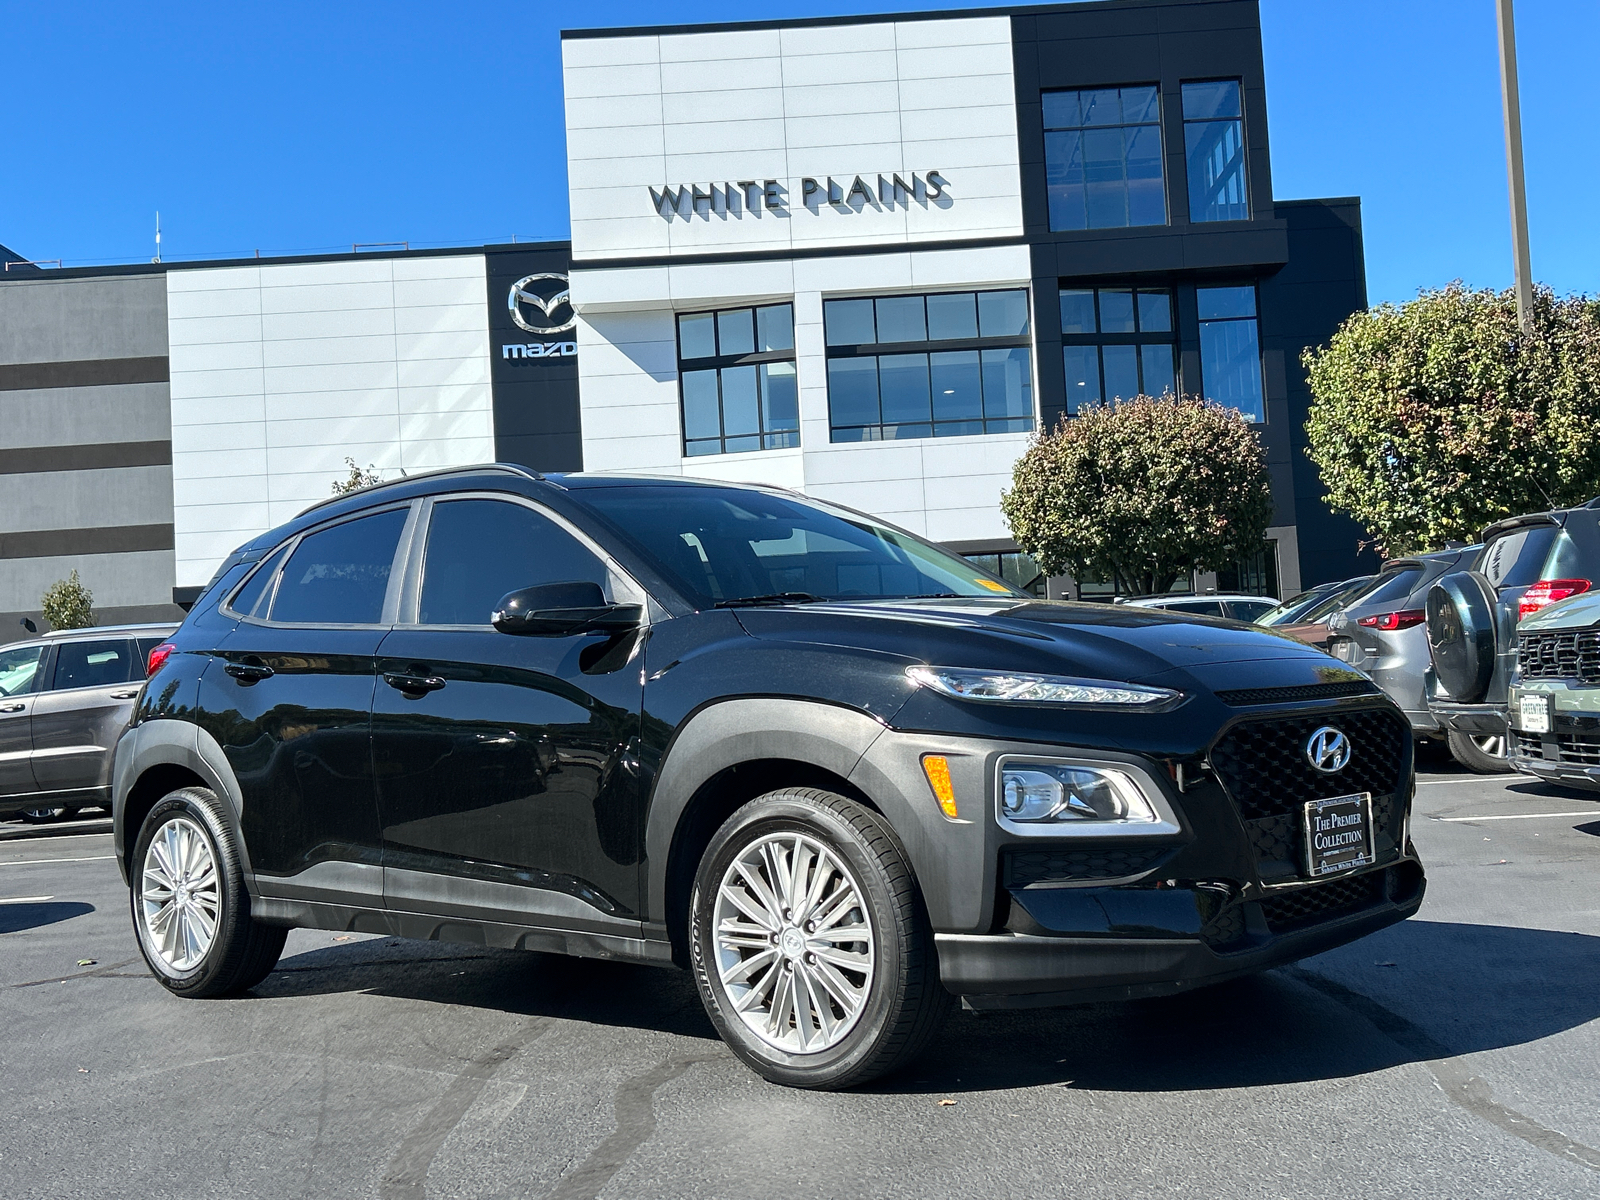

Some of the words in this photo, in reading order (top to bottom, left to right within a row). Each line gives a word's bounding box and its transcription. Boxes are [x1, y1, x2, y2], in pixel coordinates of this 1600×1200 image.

[648, 180, 780, 214] WHITE
[801, 170, 942, 206] PLAINS
[1313, 816, 1330, 832] THE
[1331, 813, 1362, 828] PREMIER
[1314, 830, 1362, 849] COLLECTION
